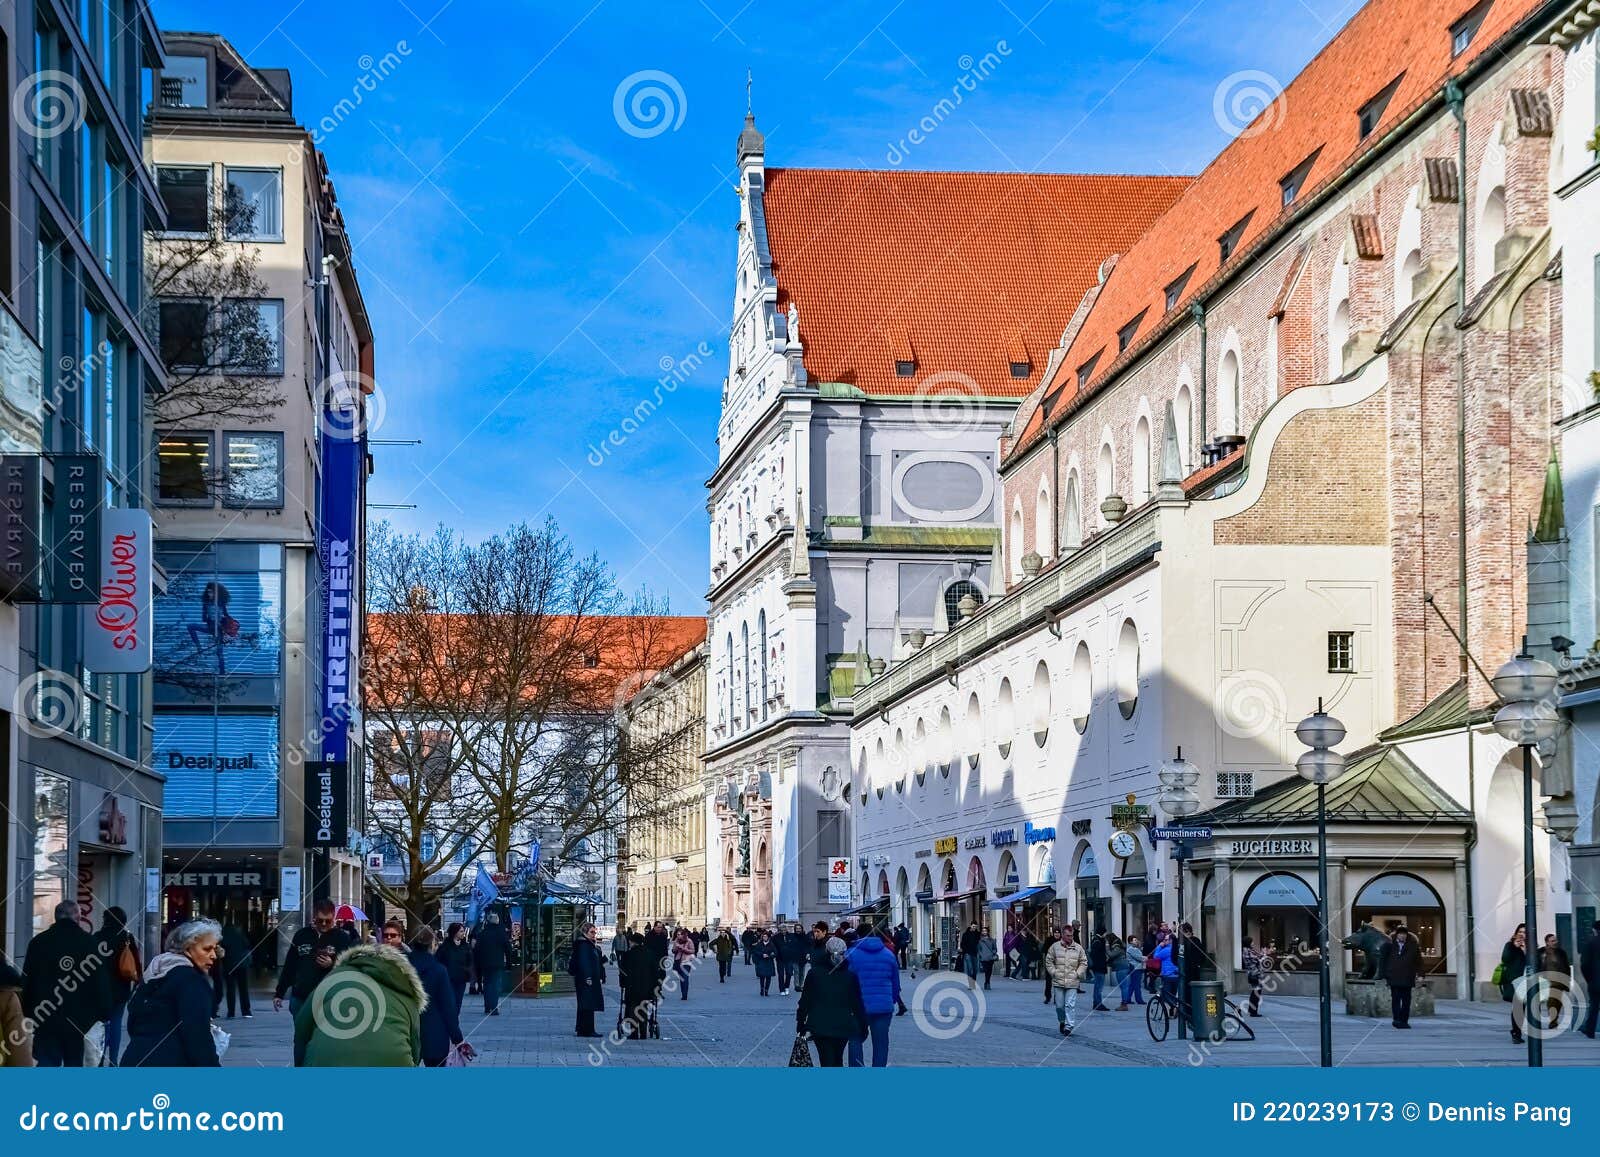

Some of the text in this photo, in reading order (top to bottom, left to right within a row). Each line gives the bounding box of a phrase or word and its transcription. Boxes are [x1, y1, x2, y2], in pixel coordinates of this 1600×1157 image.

[69, 465, 85, 590] RESERVED
[327, 539, 349, 708] TRETTER
[1154, 829, 1210, 840] Augustinerstr.
[1231, 839, 1312, 855] BUCHERER
[164, 872, 261, 886] RETTER
